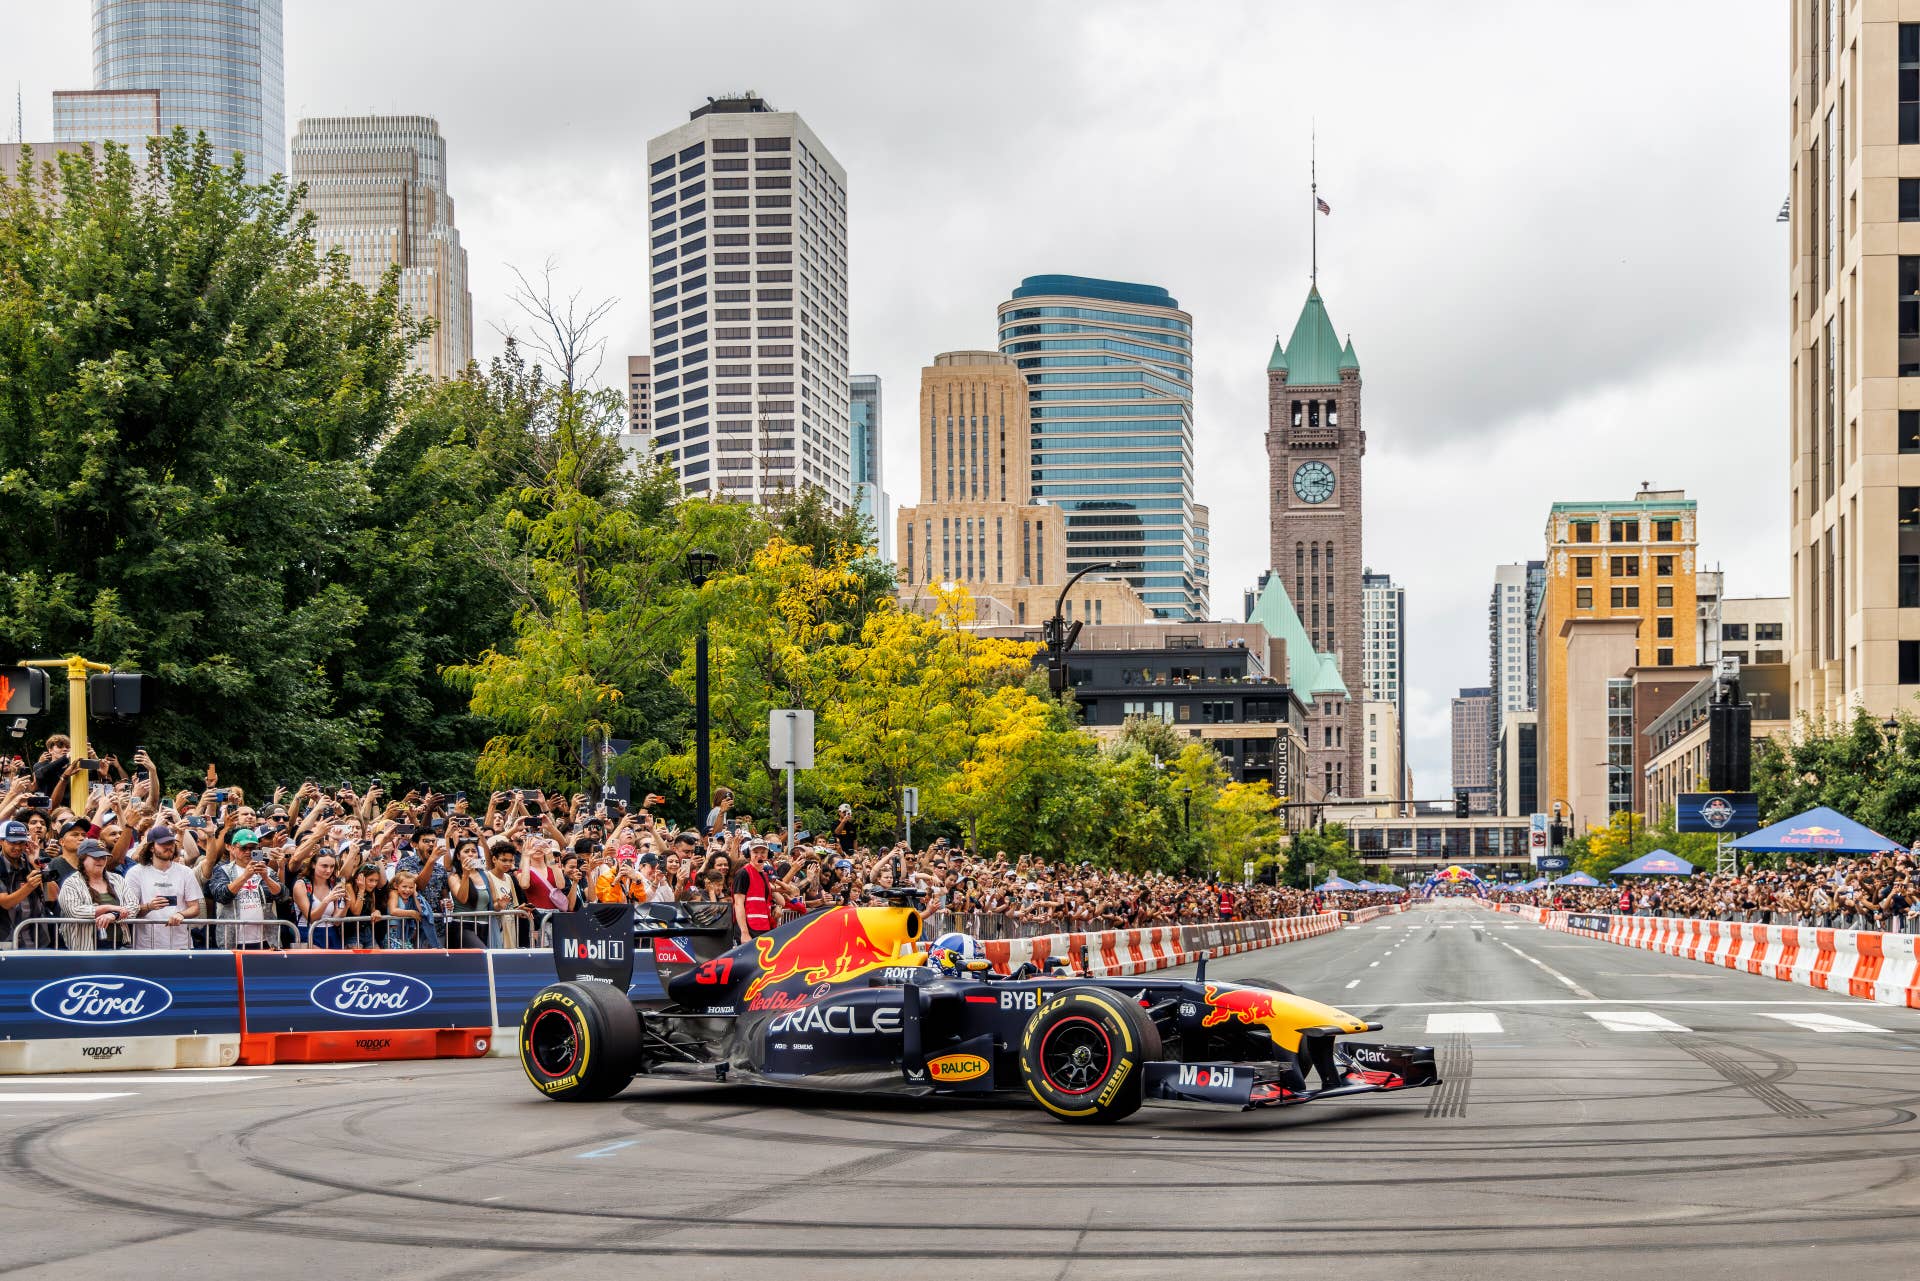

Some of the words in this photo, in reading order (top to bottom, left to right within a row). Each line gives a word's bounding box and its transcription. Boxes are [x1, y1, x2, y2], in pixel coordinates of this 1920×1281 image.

[564, 938, 606, 960] Mobil
[658, 953, 678, 961] COLA
[696, 957, 734, 985] 37
[884, 967, 917, 979] ROKT
[60, 981, 146, 1016] Ford
[335, 977, 410, 1010] Ford
[532, 991, 575, 1008] ZERO
[748, 991, 778, 1011] Red
[771, 992, 808, 1009] Bull
[707, 1006, 735, 1014] HONDA
[769, 1006, 904, 1034] ORACLE
[1023, 997, 1067, 1051] ZERO
[82, 1046, 122, 1056] YODOCK
[355, 1039, 390, 1048] YODOCK
[941, 1061, 982, 1074] RAUCH
[1178, 1064, 1234, 1088] Mobil
[1097, 1057, 1134, 1107] PIRELLI
